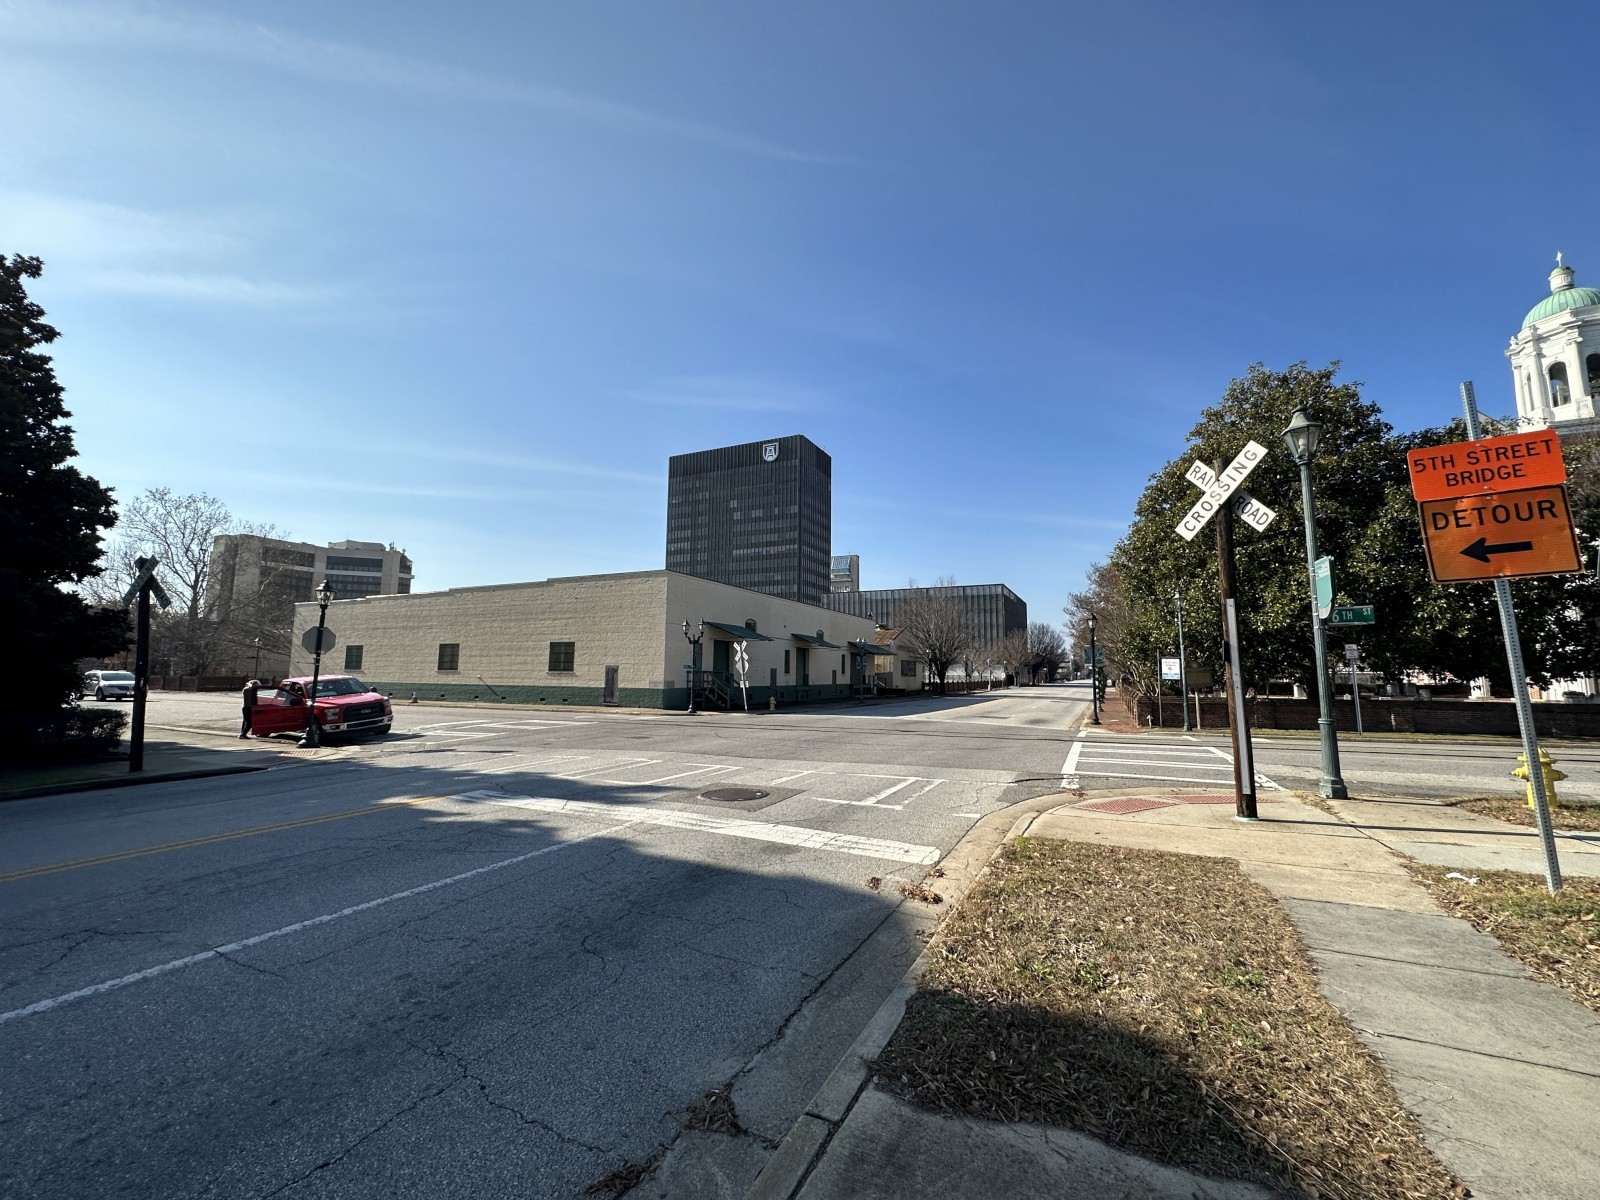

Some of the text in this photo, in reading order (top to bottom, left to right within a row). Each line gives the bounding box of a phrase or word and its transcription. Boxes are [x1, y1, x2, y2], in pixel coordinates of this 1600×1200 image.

[1414, 439, 1553, 473] 5TH STREET
[1445, 463, 1526, 487] BRIDGE
[1183, 449, 1258, 532] CROSSING
[1232, 496, 1270, 526] ROAD
[1431, 500, 1558, 531] DETOUR
[1362, 607, 1371, 615] ST
